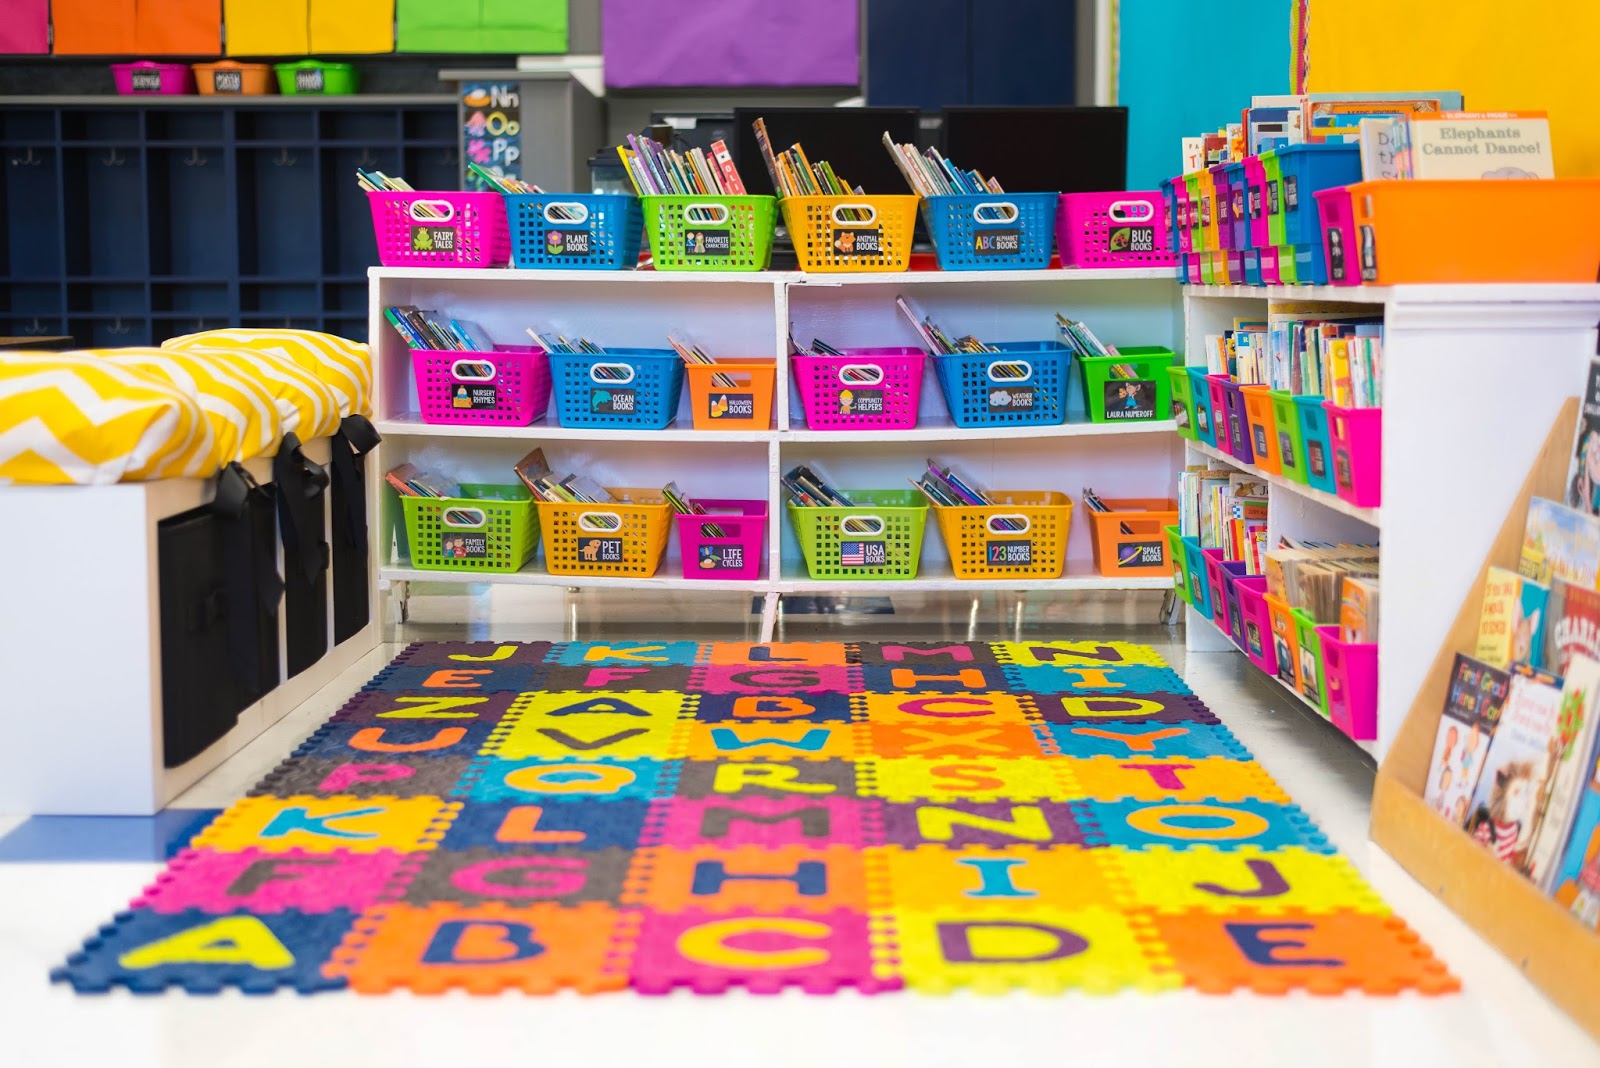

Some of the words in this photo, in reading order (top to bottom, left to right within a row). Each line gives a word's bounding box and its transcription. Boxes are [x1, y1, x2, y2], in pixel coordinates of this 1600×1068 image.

[491, 85, 519, 109] Nn
[487, 111, 520, 136] Oo
[1439, 127, 1521, 142] Elephants
[493, 138, 520, 167] Pp
[1422, 143, 1479, 156] Cannot
[1485, 142, 1541, 156] Dance!
[433, 231, 454, 241] FAIRY
[566, 234, 588, 244] PLANT
[705, 236, 729, 244] FAVORITE
[856, 235, 878, 243] ANIMAL
[1131, 229, 1152, 243] BUG
[434, 240, 453, 250] TALES
[566, 243, 588, 252] BOOKS
[856, 242, 878, 251] BOOKS
[975, 236, 995, 250] ABC
[996, 241, 1018, 250] BOOKS
[1130, 242, 1152, 251] BOOKS
[472, 389, 496, 398] NURSERY
[612, 394, 634, 403] OCEAN
[1011, 393, 1032, 401] WEATHER
[473, 396, 495, 405] RHYMES
[1012, 399, 1033, 408] BOOKS
[612, 402, 634, 411] BOOKS
[729, 405, 752, 414] BOOKS
[857, 403, 882, 411] HELPERS
[1106, 411, 1125, 420] LAURA
[1125, 410, 1153, 420] NUMEROFF
[465, 538, 485, 546] FAMILY
[465, 545, 485, 554] BOOKS
[602, 541, 621, 554] PET
[865, 544, 885, 556] USA
[1007, 545, 1030, 554] NUMBER
[1142, 546, 1162, 555] SPACE
[722, 548, 742, 560] LIFE
[865, 555, 885, 563] BOOKS
[988, 546, 1007, 562] 123
[1007, 553, 1030, 562] BOOKS
[1142, 554, 1162, 563] BOOKS
[722, 559, 743, 568] CYCLES
[449, 645, 519, 662] J
[583, 645, 669, 662] K
[749, 646, 805, 661] L
[883, 645, 975, 662] M
[1029, 645, 1123, 663] N
[423, 669, 493, 687] E
[582, 668, 650, 686] F
[730, 669, 822, 688] G
[892, 669, 986, 688] H
[1072, 669, 1127, 687] I
[1458, 662, 1482, 687] First
[1481, 671, 1508, 698] Grad
[1451, 684, 1476, 711] Here
[377, 697, 488, 717] Z
[547, 698, 653, 716] A
[733, 697, 815, 717] B
[899, 698, 995, 717] C
[1061, 697, 1164, 716] D
[349, 727, 467, 752] U
[537, 728, 650, 750] V
[710, 728, 831, 751] W
[903, 728, 1005, 751] X
[1072, 728, 1189, 751] Y
[319, 764, 415, 791] P
[505, 764, 636, 793] Q
[713, 762, 836, 794] R
[929, 764, 1004, 791] S
[1121, 764, 1195, 789] T
[260, 807, 388, 839] K
[496, 806, 587, 843] L
[701, 806, 830, 839] M
[915, 806, 1053, 841] N
[1126, 805, 1269, 839] O
[226, 859, 342, 896] F
[451, 856, 590, 897] G
[692, 860, 827, 897] H
[956, 858, 1039, 897] I
[1193, 860, 1292, 898] J
[119, 915, 295, 969] A
[421, 920, 547, 965] B
[678, 917, 831, 969] C
[936, 920, 1088, 964] D
[1225, 922, 1345, 966] E
